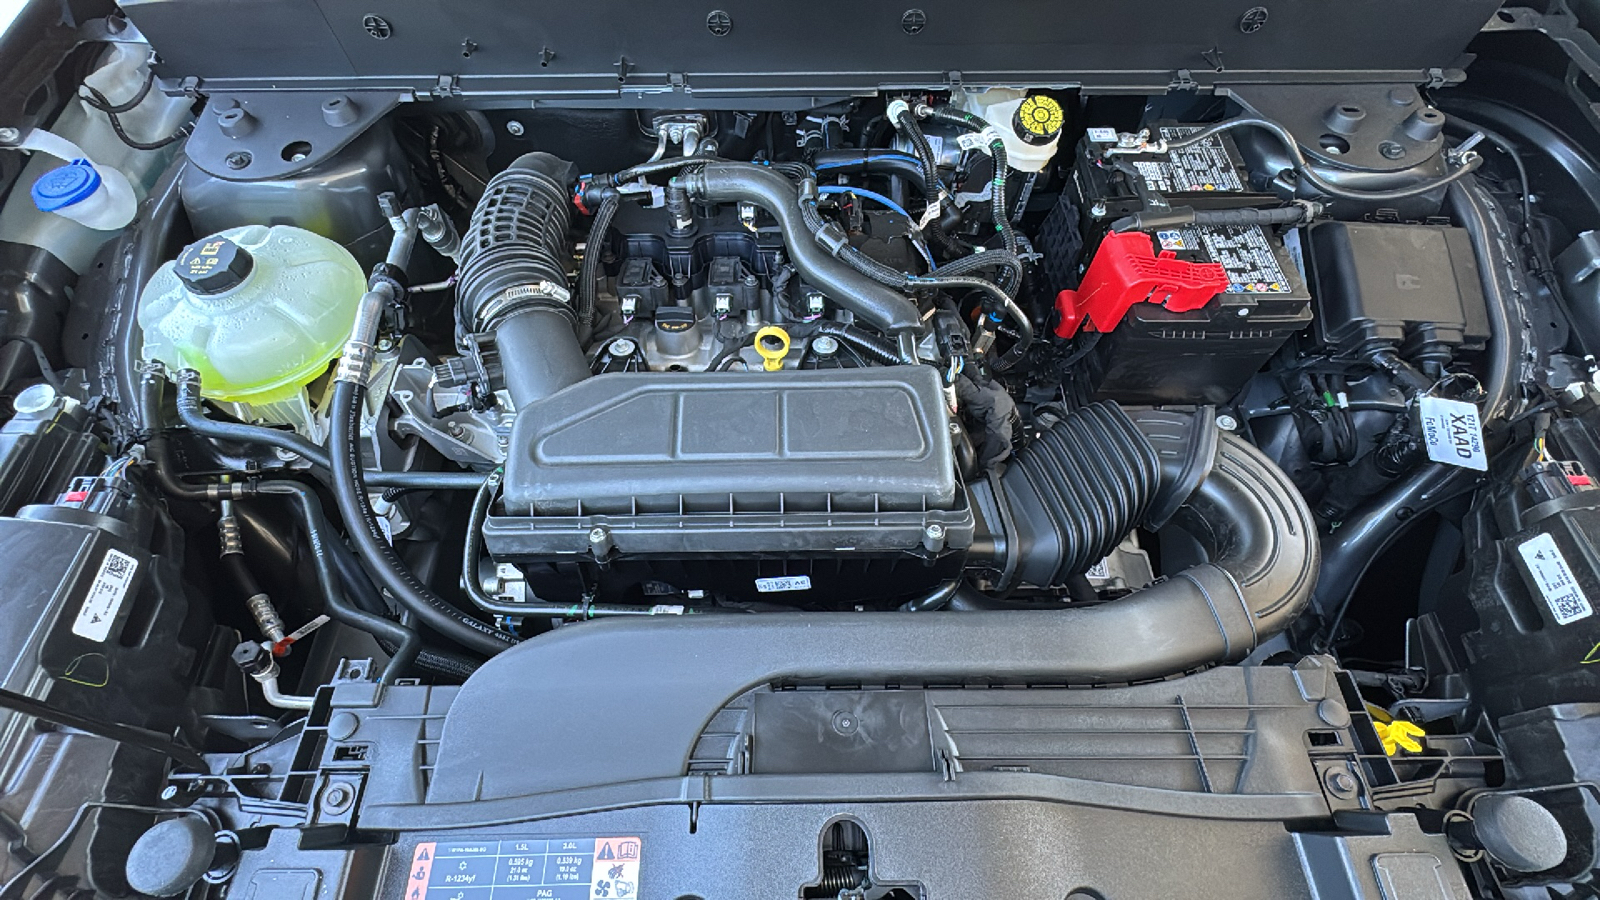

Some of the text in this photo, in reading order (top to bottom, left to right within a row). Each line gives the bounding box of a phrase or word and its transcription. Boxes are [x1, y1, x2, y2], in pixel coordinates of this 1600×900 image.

[1449, 412, 1472, 459] XAAD
[462, 617, 494, 635] GALAXY
[515, 843, 529, 851] 1.5L
[525, 857, 534, 867] kg
[573, 856, 583, 866] kg
[445, 874, 476, 884] R-1234yf
[536, 889, 553, 898] PAG
